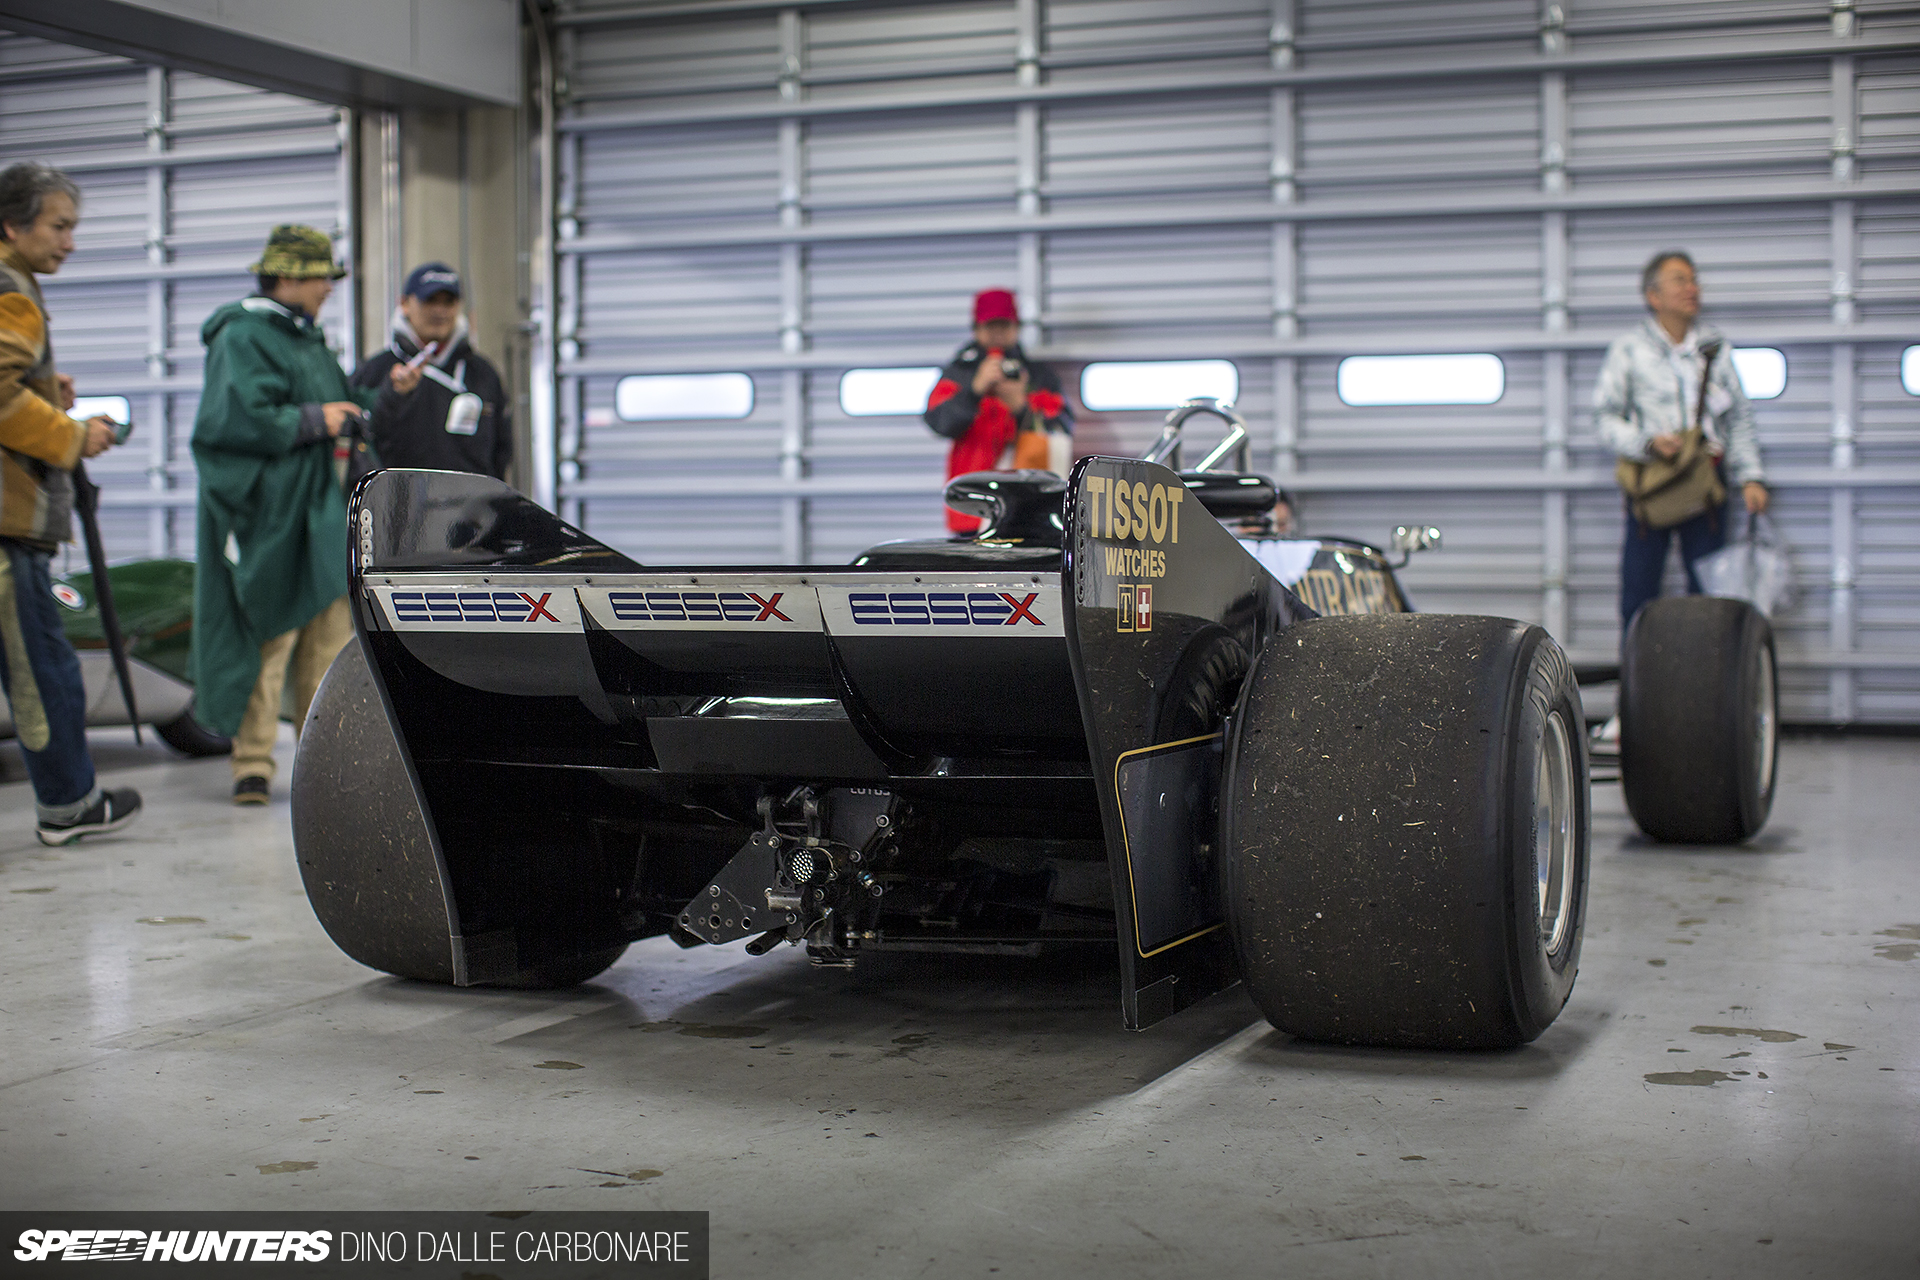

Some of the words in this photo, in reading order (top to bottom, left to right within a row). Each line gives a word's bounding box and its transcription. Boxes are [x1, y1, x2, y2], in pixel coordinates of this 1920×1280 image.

[1086, 475, 1184, 544] TISSOT
[1104, 547, 1166, 578] WATCHES
[391, 592, 562, 623] ESSEX
[608, 592, 794, 623] ESSEX
[848, 592, 1047, 626] ESSEX
